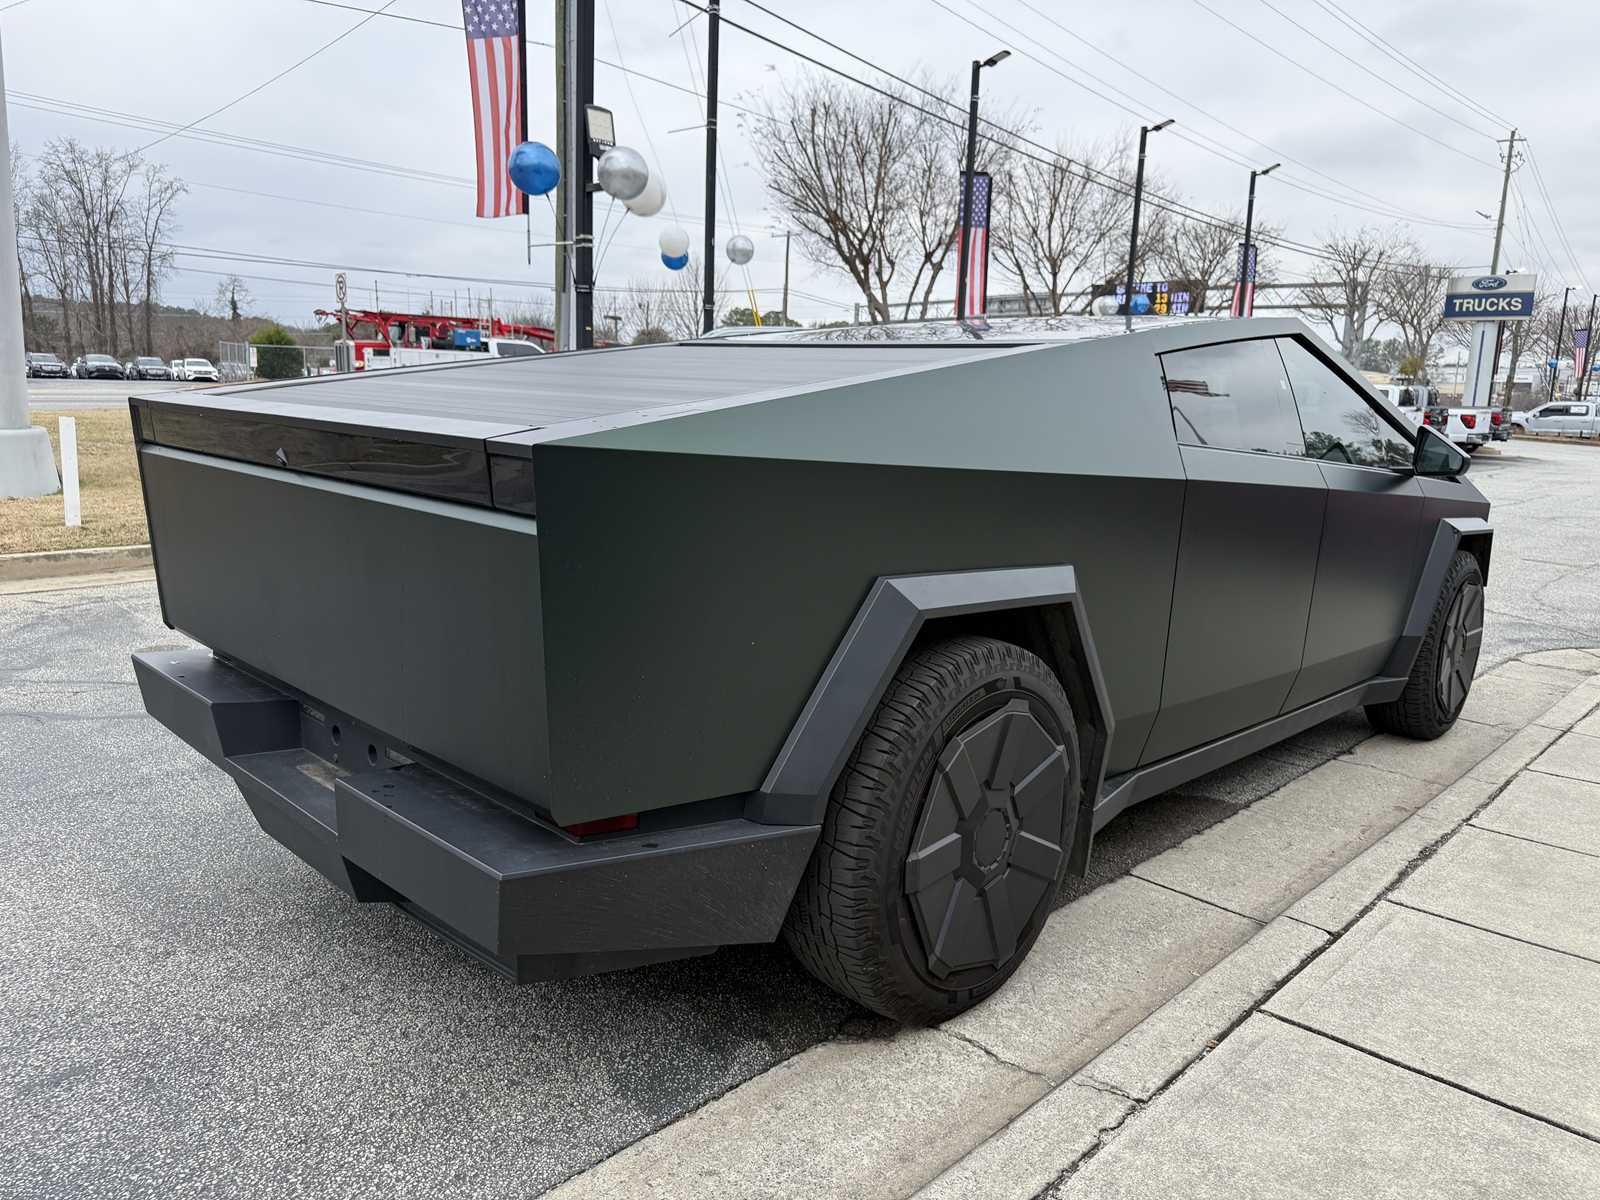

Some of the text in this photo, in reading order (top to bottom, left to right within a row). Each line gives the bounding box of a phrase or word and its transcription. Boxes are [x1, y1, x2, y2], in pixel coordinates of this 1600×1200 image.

[1156, 282, 1168, 292] TO
[1478, 278, 1500, 288] Ford
[1155, 293, 1168, 303] 13
[1453, 297, 1523, 312] TRUCKS
[893, 745, 933, 852] MICHELIN
